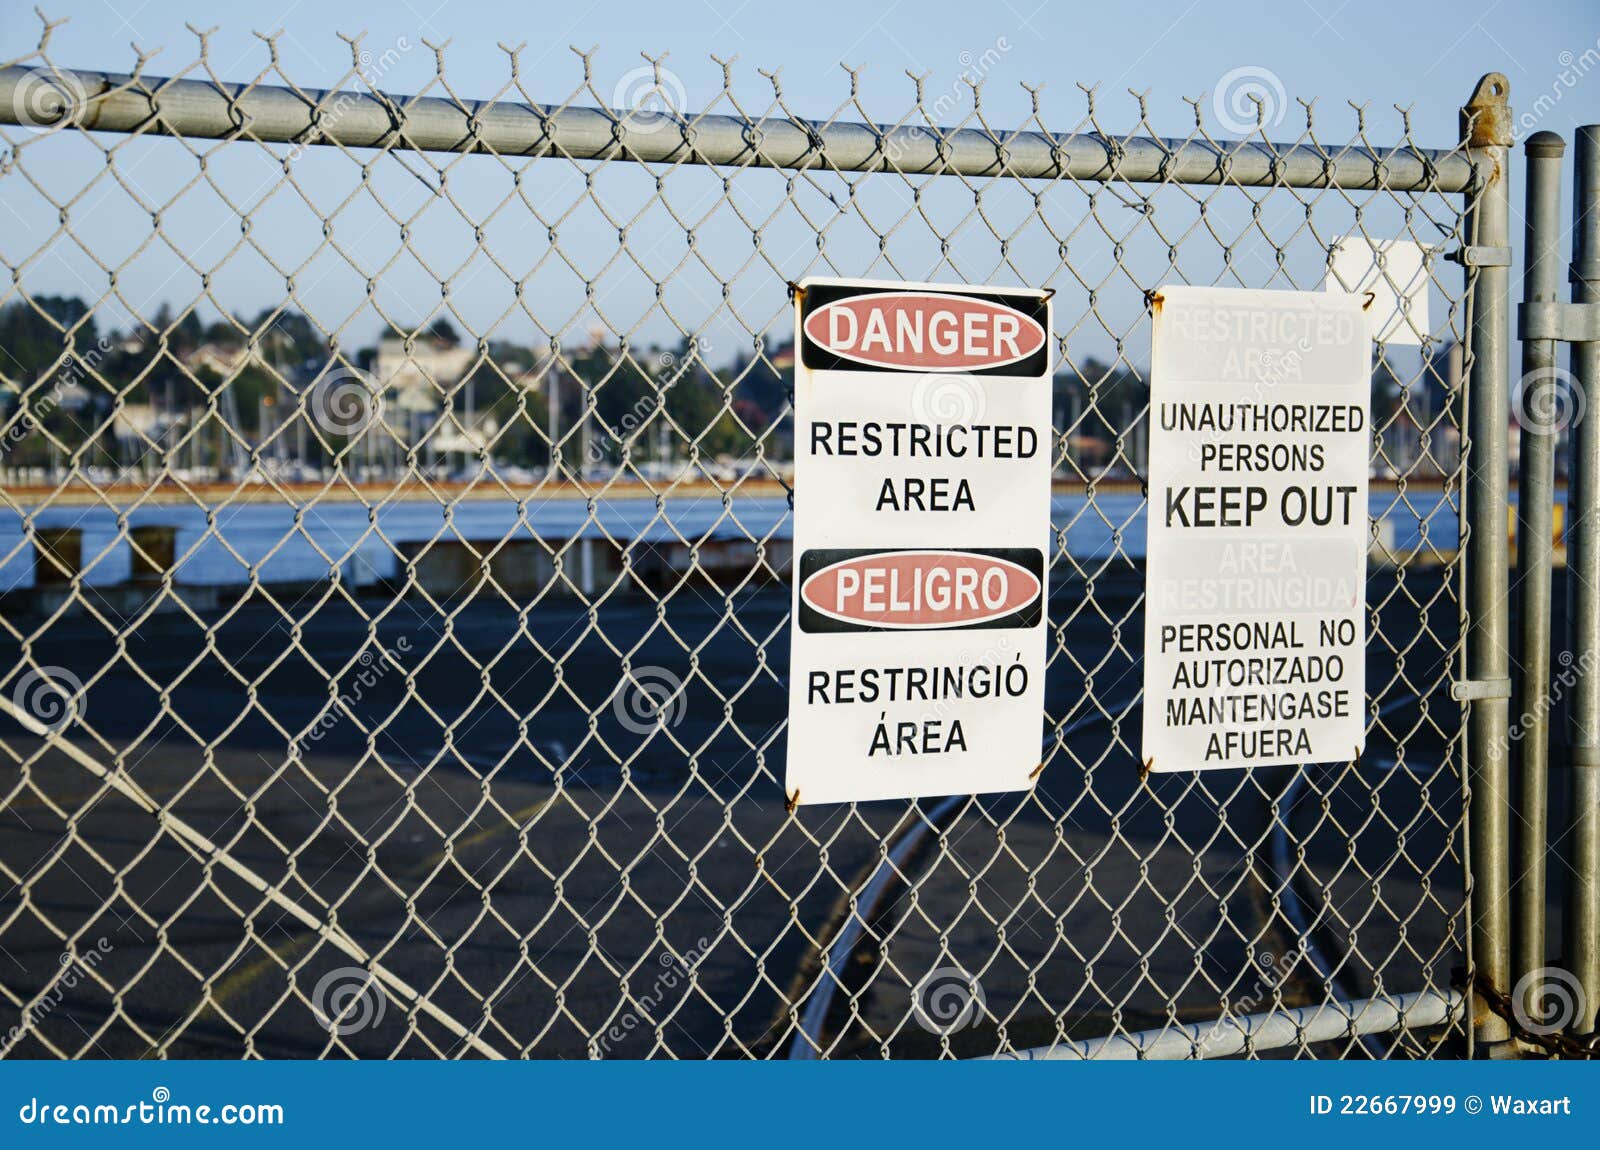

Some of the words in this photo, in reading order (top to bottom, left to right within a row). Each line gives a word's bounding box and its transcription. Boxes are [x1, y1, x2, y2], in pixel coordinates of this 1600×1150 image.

[828, 306, 1021, 357] DANGER
[1160, 403, 1364, 432] UNAUTHORIZED
[811, 421, 1038, 459] RESTRICTED
[1201, 444, 1325, 472] PERSONS
[876, 478, 976, 511] AREA
[1166, 486, 1268, 527] KEEP
[1281, 486, 1357, 526] OUT
[836, 566, 1009, 613] PELIGRO
[1161, 621, 1304, 653] PERSONAL
[1320, 619, 1356, 647] NO
[808, 653, 1029, 704] RESTRINGIÓ
[1172, 655, 1344, 689] AUTORIZADO
[1166, 690, 1349, 727] MANTENGASE
[868, 712, 967, 757] ÁREA
[1205, 728, 1312, 761] AFUERA
